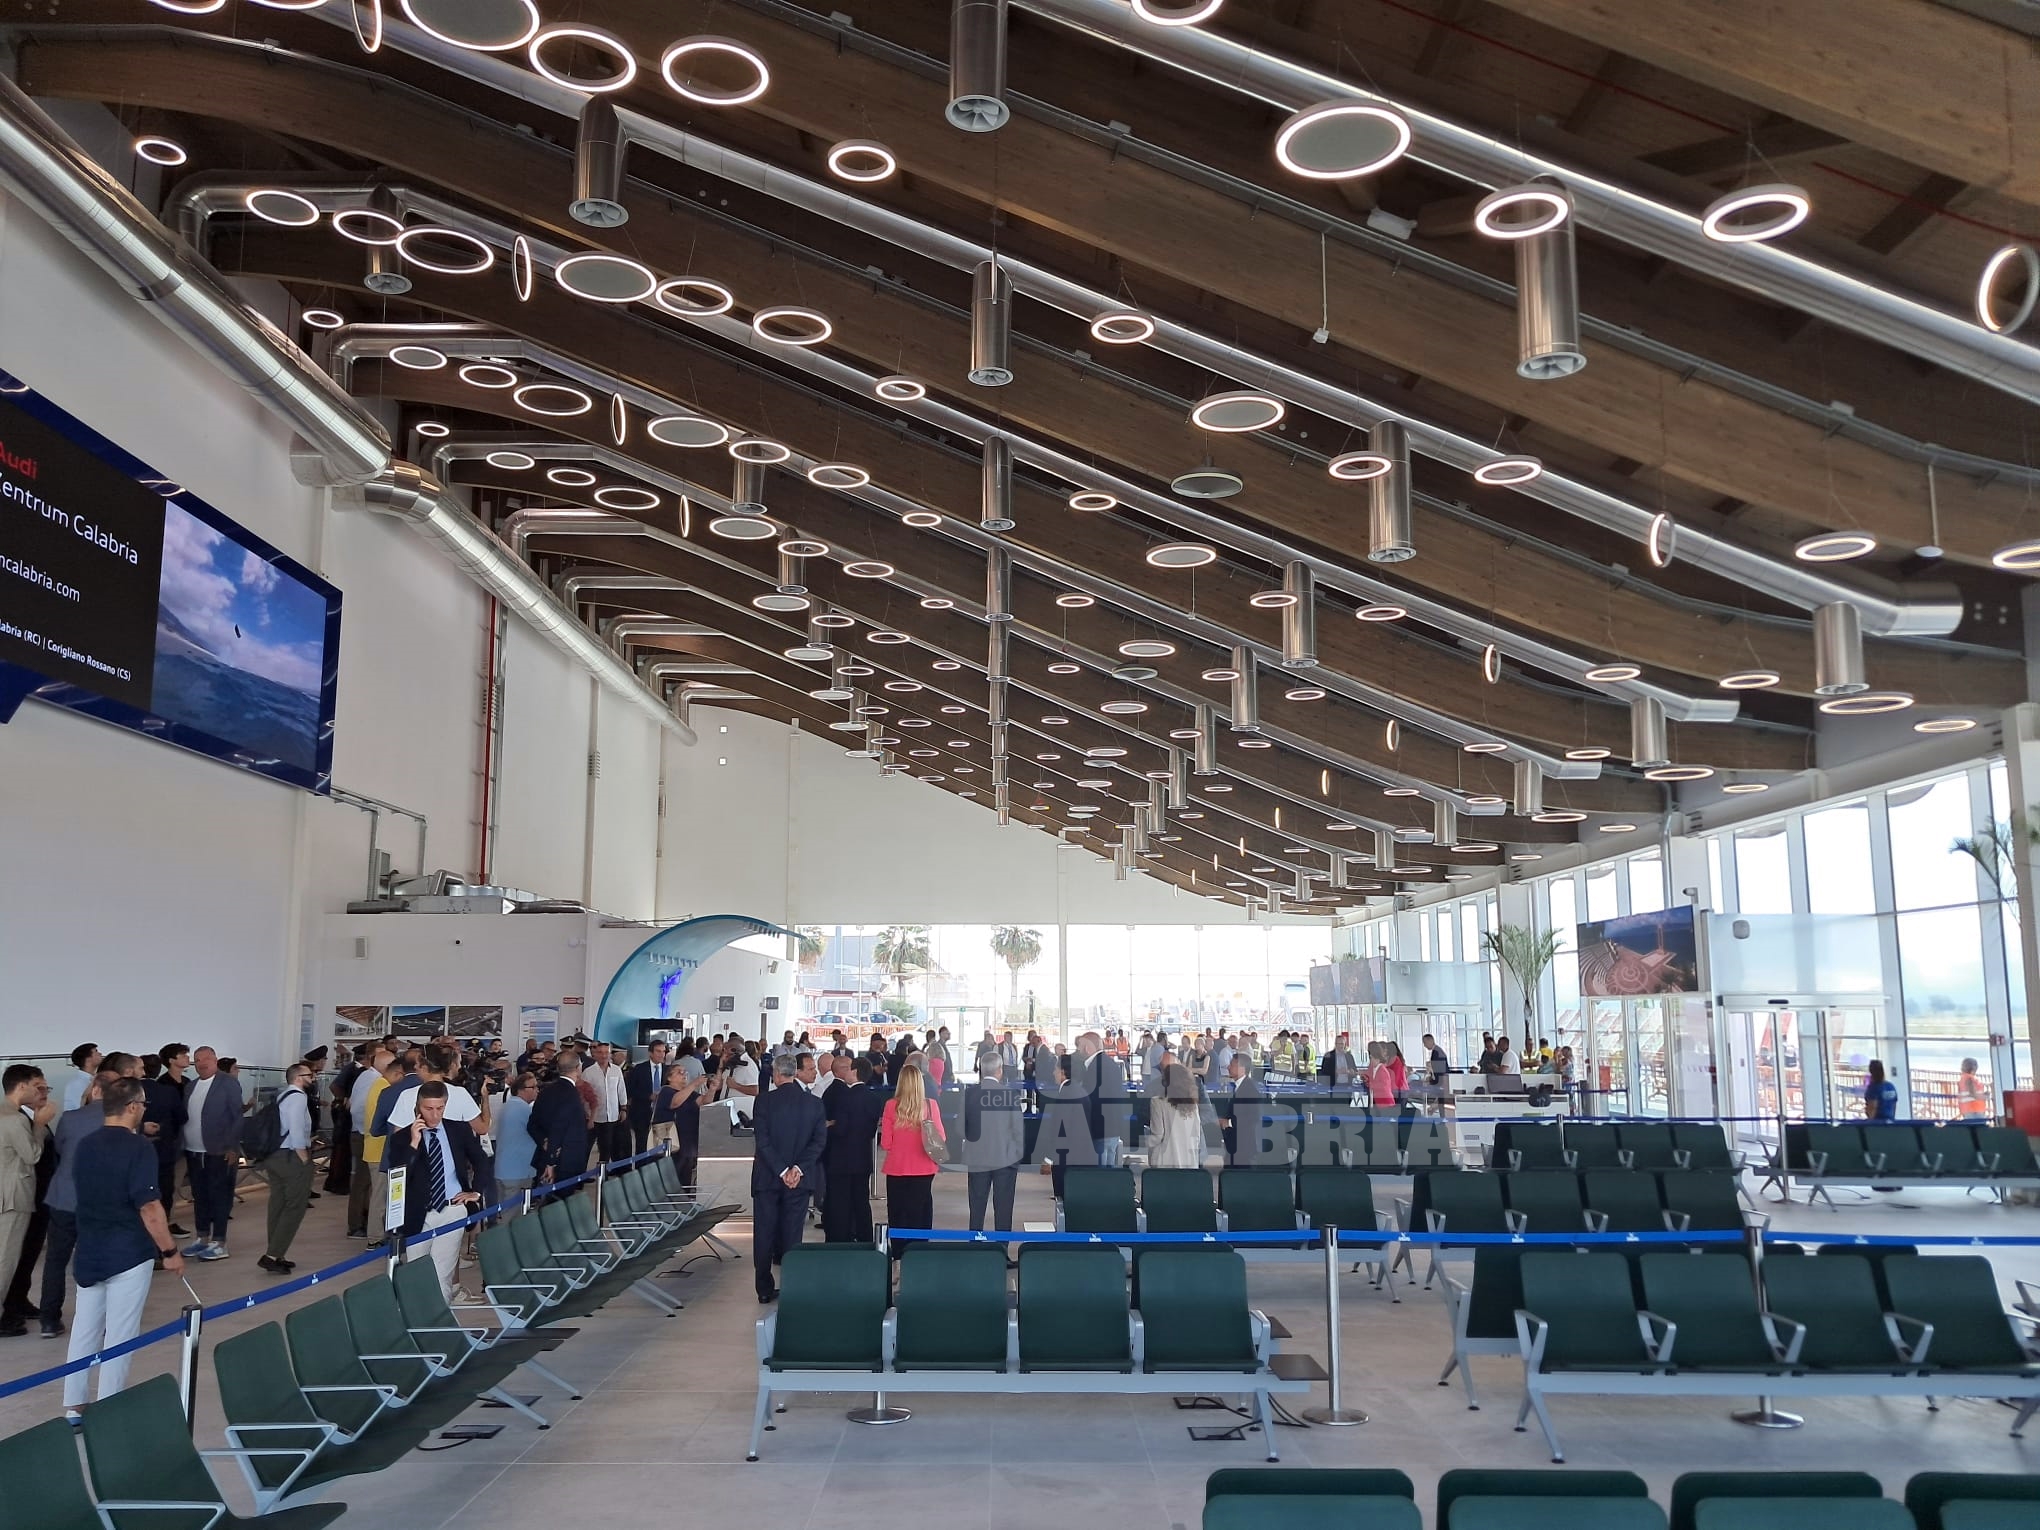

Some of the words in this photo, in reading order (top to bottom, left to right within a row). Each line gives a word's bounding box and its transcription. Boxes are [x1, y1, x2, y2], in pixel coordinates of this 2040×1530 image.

[0, 472, 69, 528] entrum
[73, 514, 138, 565] Calabria
[24, 630, 41, 646] (RC)
[47, 640, 86, 663] Corigliano
[86, 654, 116, 675] Rossano
[117, 667, 131, 682] (CS)
